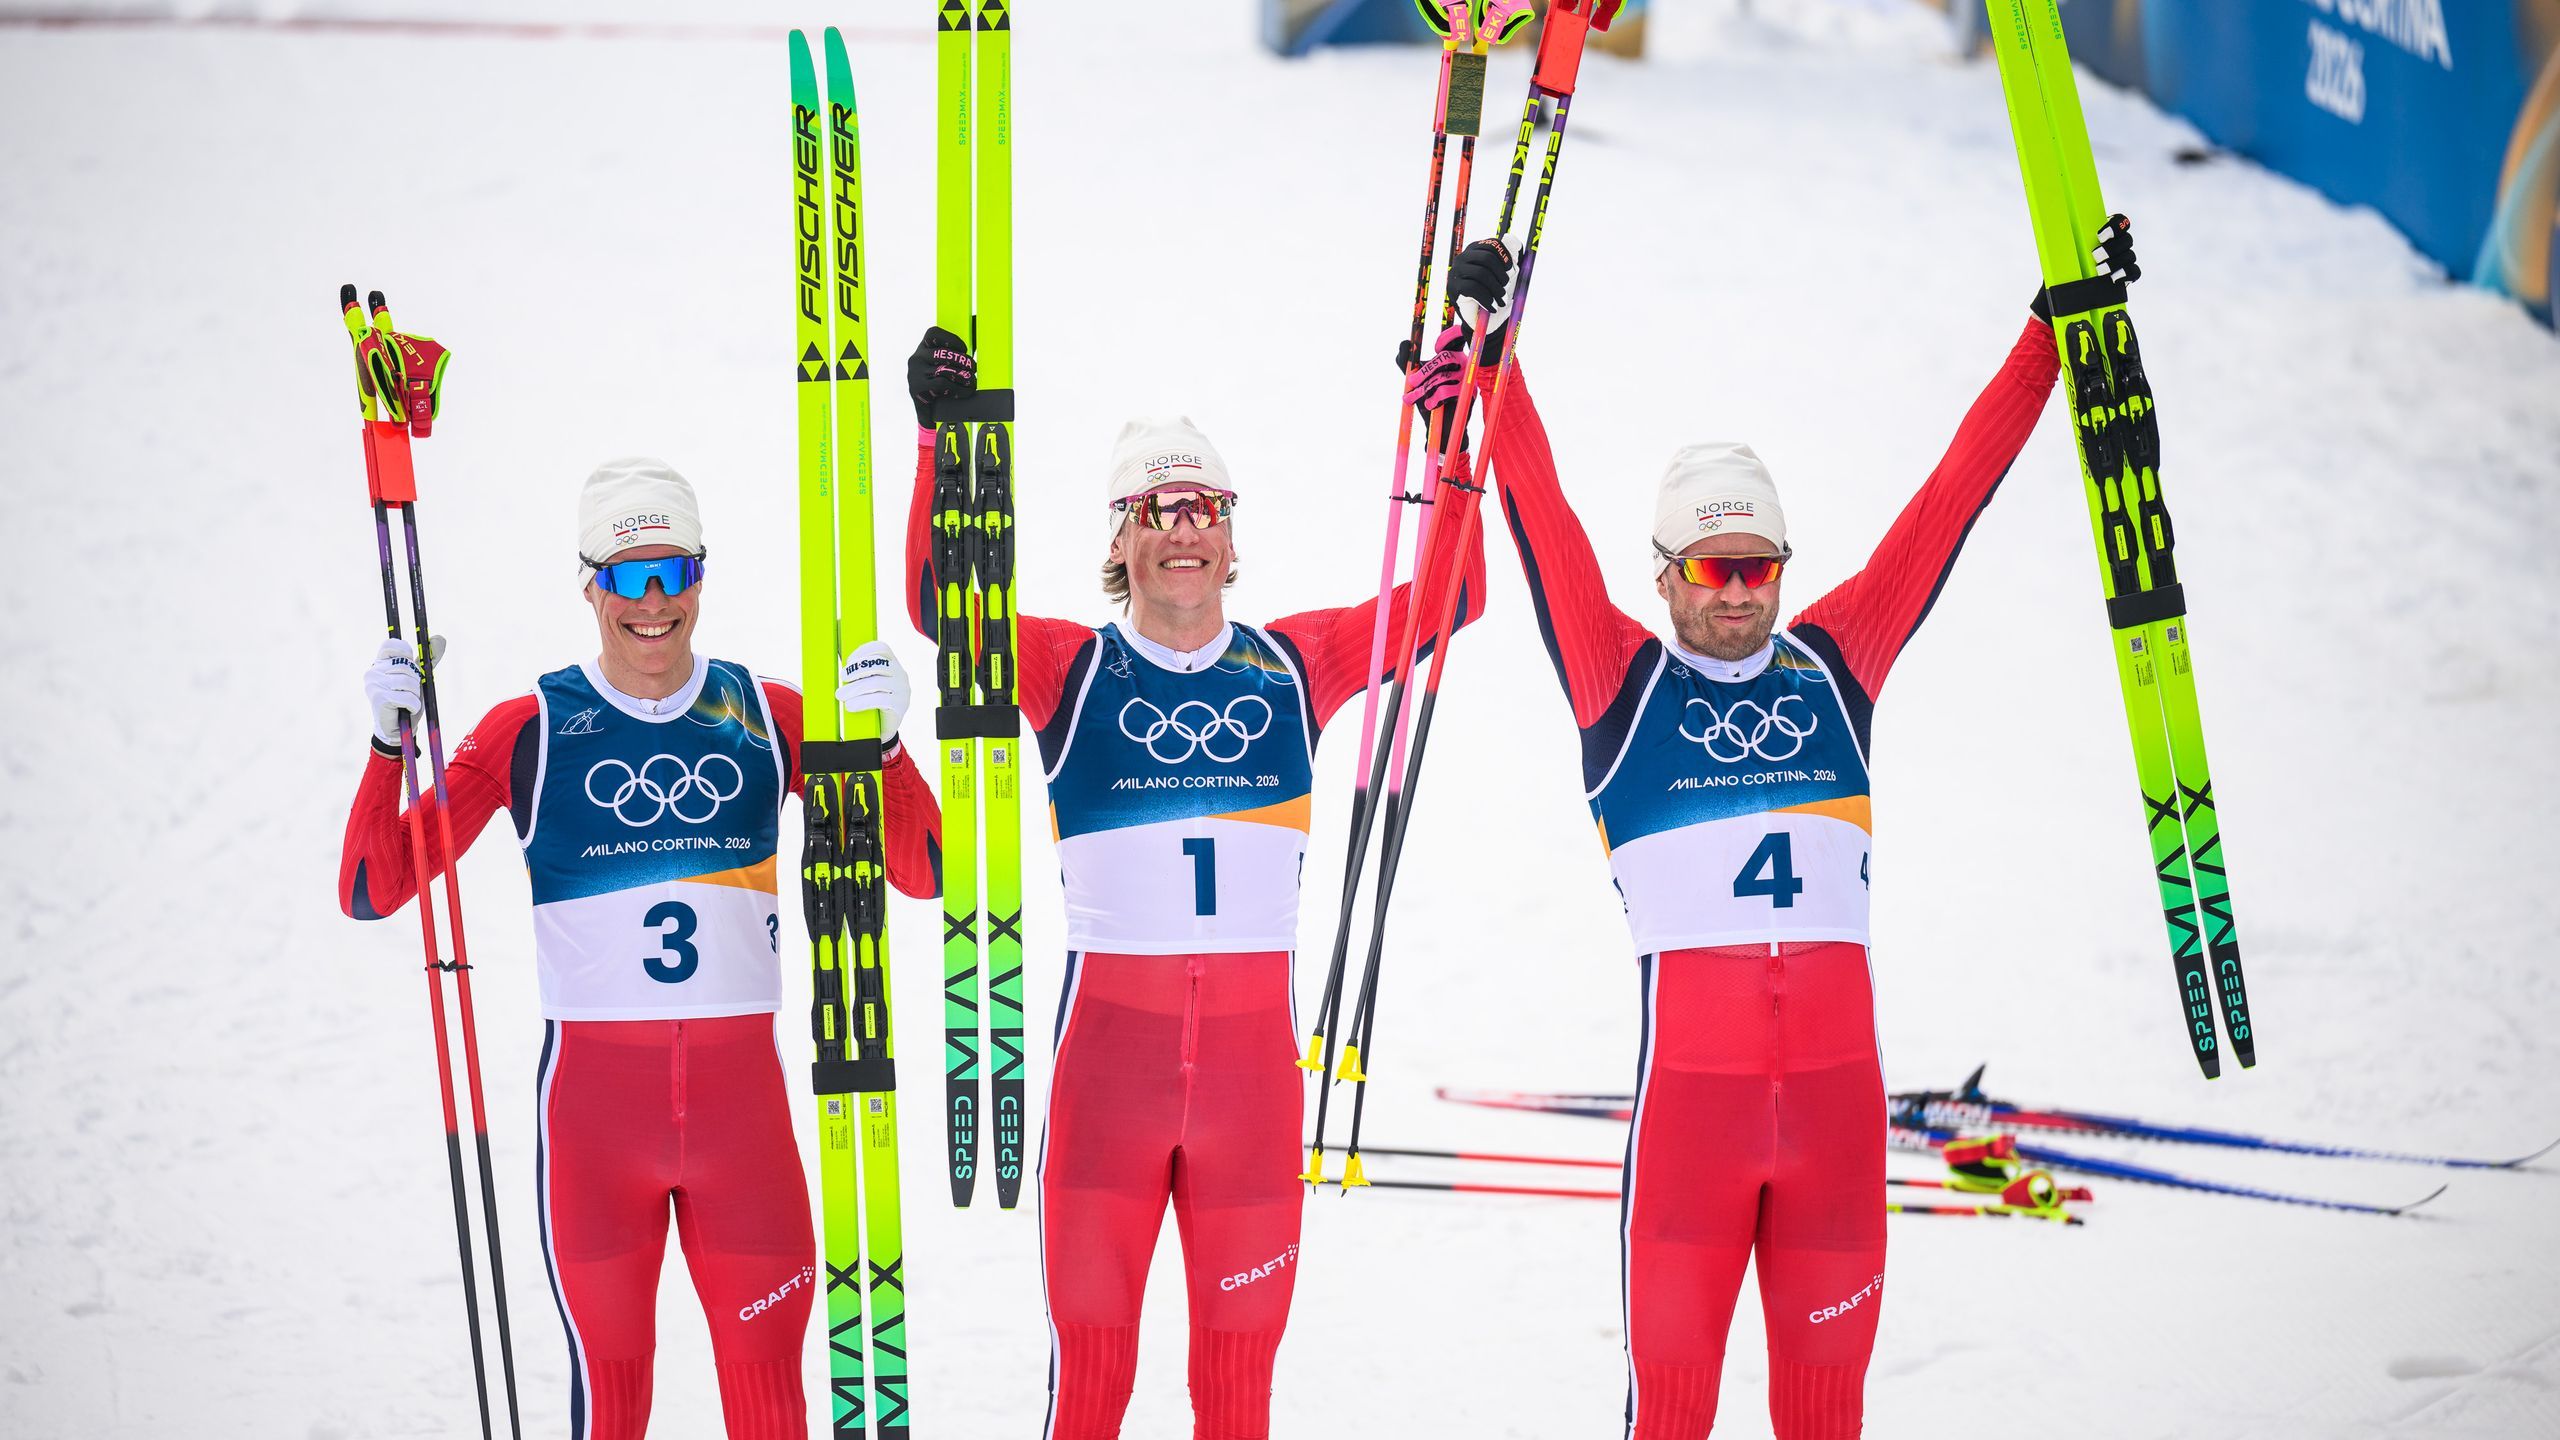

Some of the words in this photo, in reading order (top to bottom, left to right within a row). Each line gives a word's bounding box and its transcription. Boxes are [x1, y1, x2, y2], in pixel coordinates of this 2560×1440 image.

[1510, 98, 1540, 176] LEKI
[795, 104, 822, 325] FISCHER
[832, 102, 860, 323] FISCHER
[933, 349, 973, 369] HESTRA
[1145, 454, 1202, 469] NORGE
[612, 514, 671, 532] NORGE
[1696, 501, 1754, 516] NORGE
[1111, 776, 1179, 790] MILANO
[1183, 775, 1253, 788] CORTINA
[1256, 775, 1279, 787] 2026
[1668, 775, 1739, 791] MILANO
[1742, 770, 1811, 785] CORTINA
[1814, 769, 1837, 782] 2026
[581, 840, 648, 858] MILANO
[655, 837, 721, 851] CORTINA
[725, 837, 751, 849] 2026
[1182, 837, 1217, 916] 1
[1733, 831, 1803, 908] 4
[2141, 787, 2204, 959] MAX
[2175, 776, 2238, 946] MAX
[642, 900, 699, 984] 3
[943, 903, 978, 1080] MAX
[987, 902, 1024, 1080] MAX
[2185, 970, 2215, 1052] SPEED
[2221, 958, 2249, 1042] SPEED
[955, 1095, 972, 1179] SPEED
[1001, 1095, 1019, 1180] SPEED
[739, 1274, 802, 1321] CRAFT
[1220, 1253, 1287, 1291] CRAFT
[1809, 1283, 1873, 1324] CRAFT
